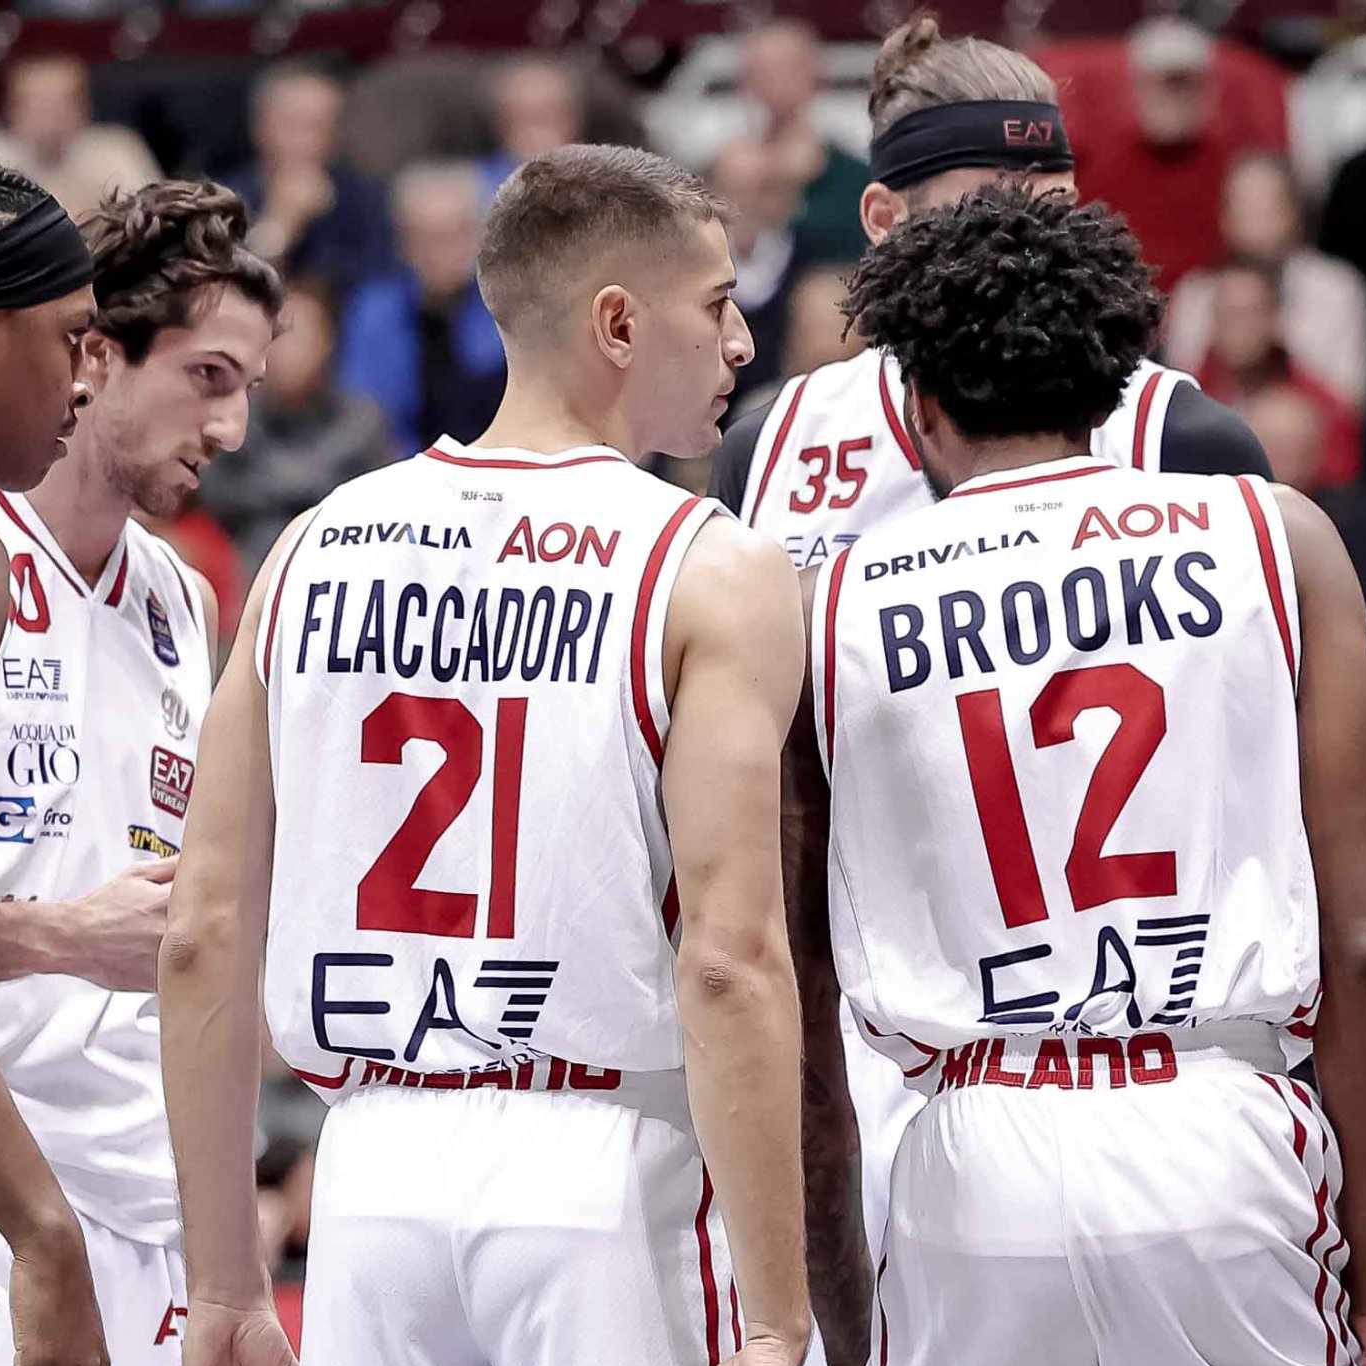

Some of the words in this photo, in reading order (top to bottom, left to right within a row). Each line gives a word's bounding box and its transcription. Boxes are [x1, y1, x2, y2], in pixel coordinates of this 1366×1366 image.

[1003, 119, 1053, 141] EA7
[788, 435, 873, 514] 35
[319, 521, 473, 550] DRIVALIA
[496, 515, 621, 568] AON
[863, 529, 1041, 582] DRIVALIA
[1070, 502, 1210, 551] AON
[8, 553, 51, 634] 0
[296, 579, 614, 684] FLACCADORI
[879, 550, 1223, 695] BROOKS
[3, 658, 62, 690] EA7
[7, 738, 81, 788] GIÒ
[9, 722, 56, 742] ACQUA
[59, 723, 76, 741] DI
[154, 752, 194, 793] EA7
[955, 662, 1179, 930] 12
[43, 808, 72, 826] Gro
[356, 691, 529, 939] 21
[311, 952, 561, 1063] EA7
[977, 914, 1211, 1030] EA7
[934, 1031, 1179, 1090] MILANO
